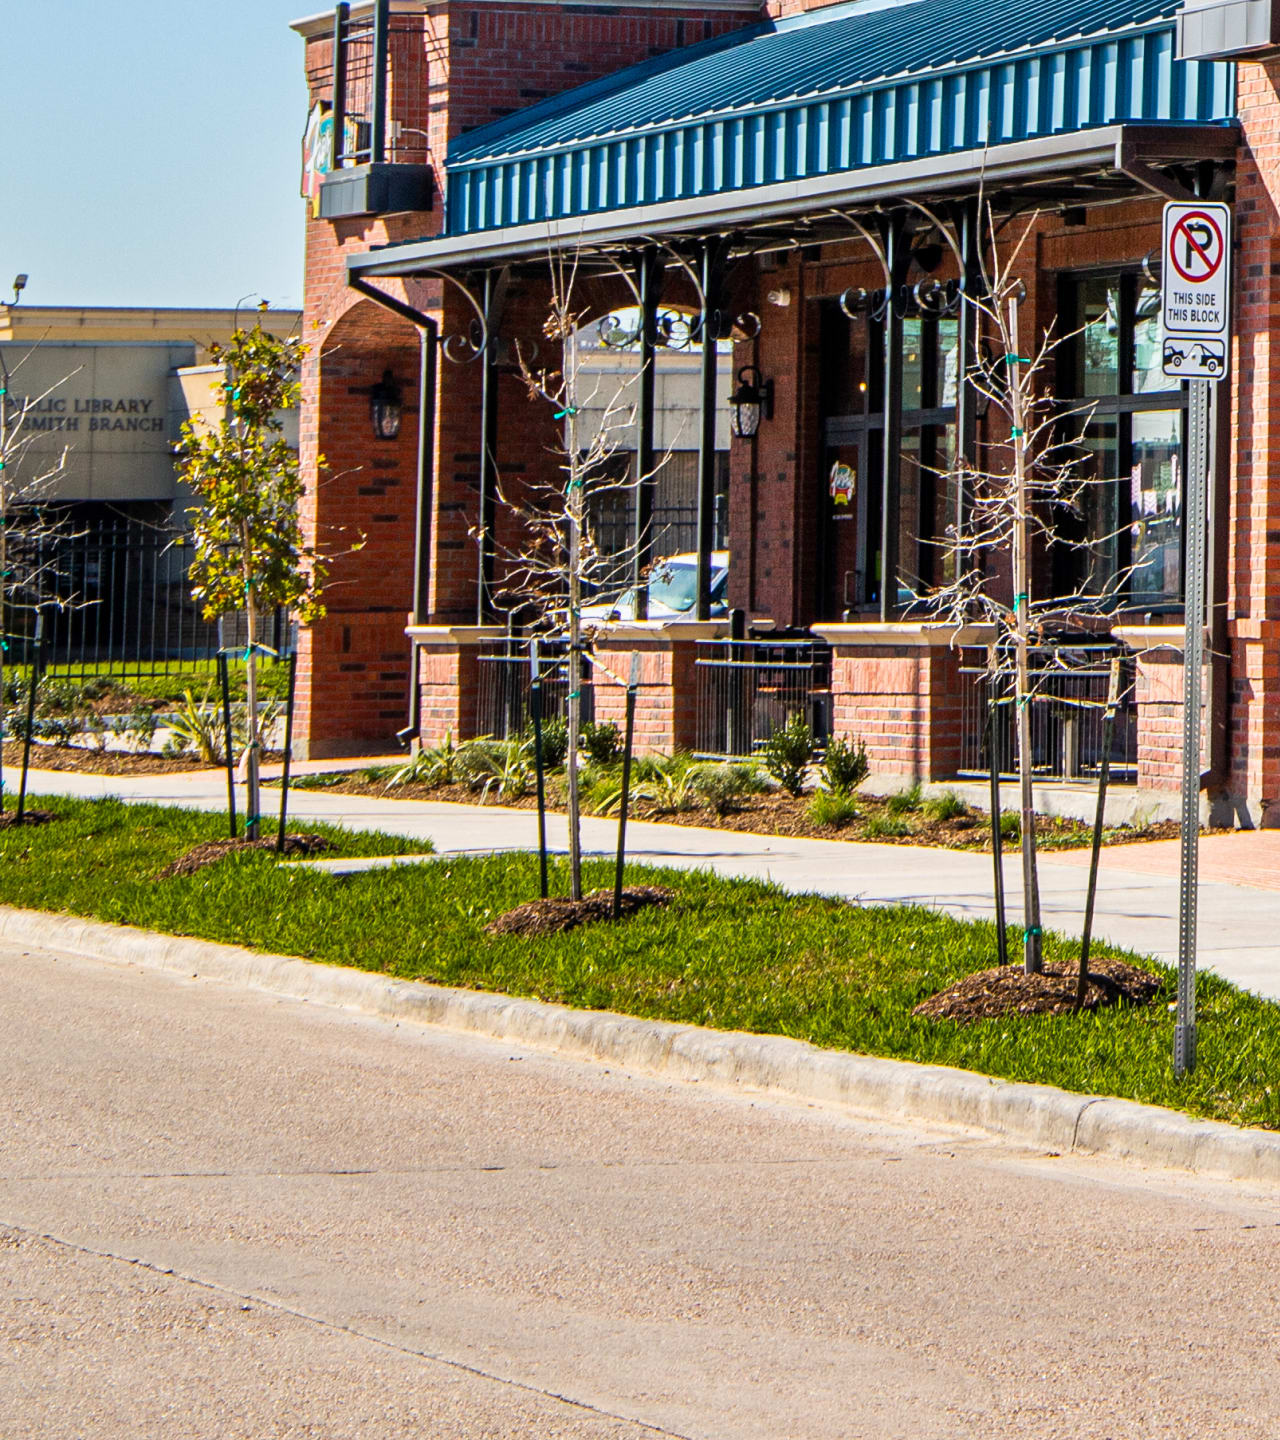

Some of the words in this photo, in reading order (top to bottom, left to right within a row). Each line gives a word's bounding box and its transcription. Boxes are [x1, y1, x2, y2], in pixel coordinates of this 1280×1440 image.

[1173, 292, 1193, 305] THIS
[1196, 293, 1216, 306] SIDE
[1168, 308, 1188, 322] THIS
[1190, 309, 1220, 323] BLOCK
[74, 398, 153, 413] LIBRARY
[22, 417, 79, 431] SMITH
[88, 417, 164, 432] BRANCH
